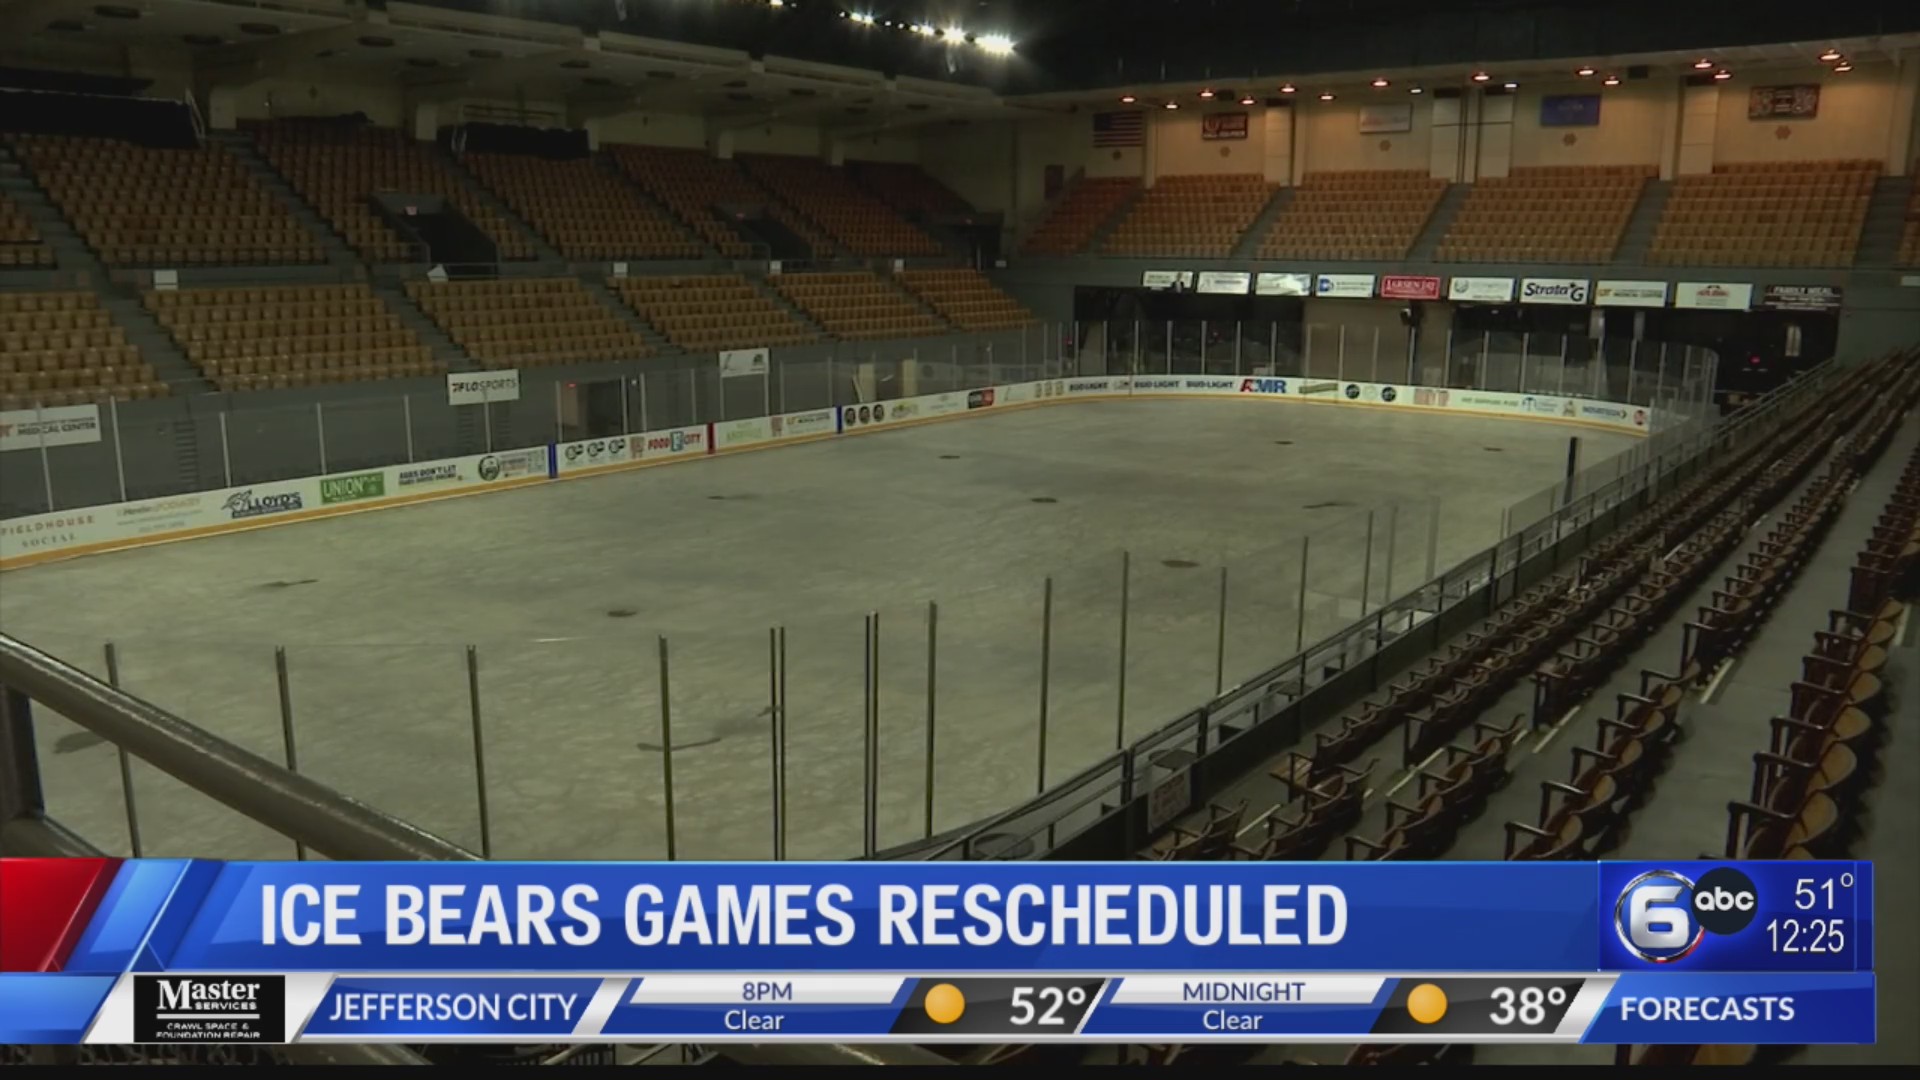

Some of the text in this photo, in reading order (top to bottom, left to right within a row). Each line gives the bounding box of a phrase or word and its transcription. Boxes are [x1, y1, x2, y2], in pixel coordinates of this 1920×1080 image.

[17, 424, 60, 436] MEDICAL
[62, 421, 97, 433] CENTER
[323, 478, 365, 498] UNION
[22, 533, 76, 548] SOCIAL
